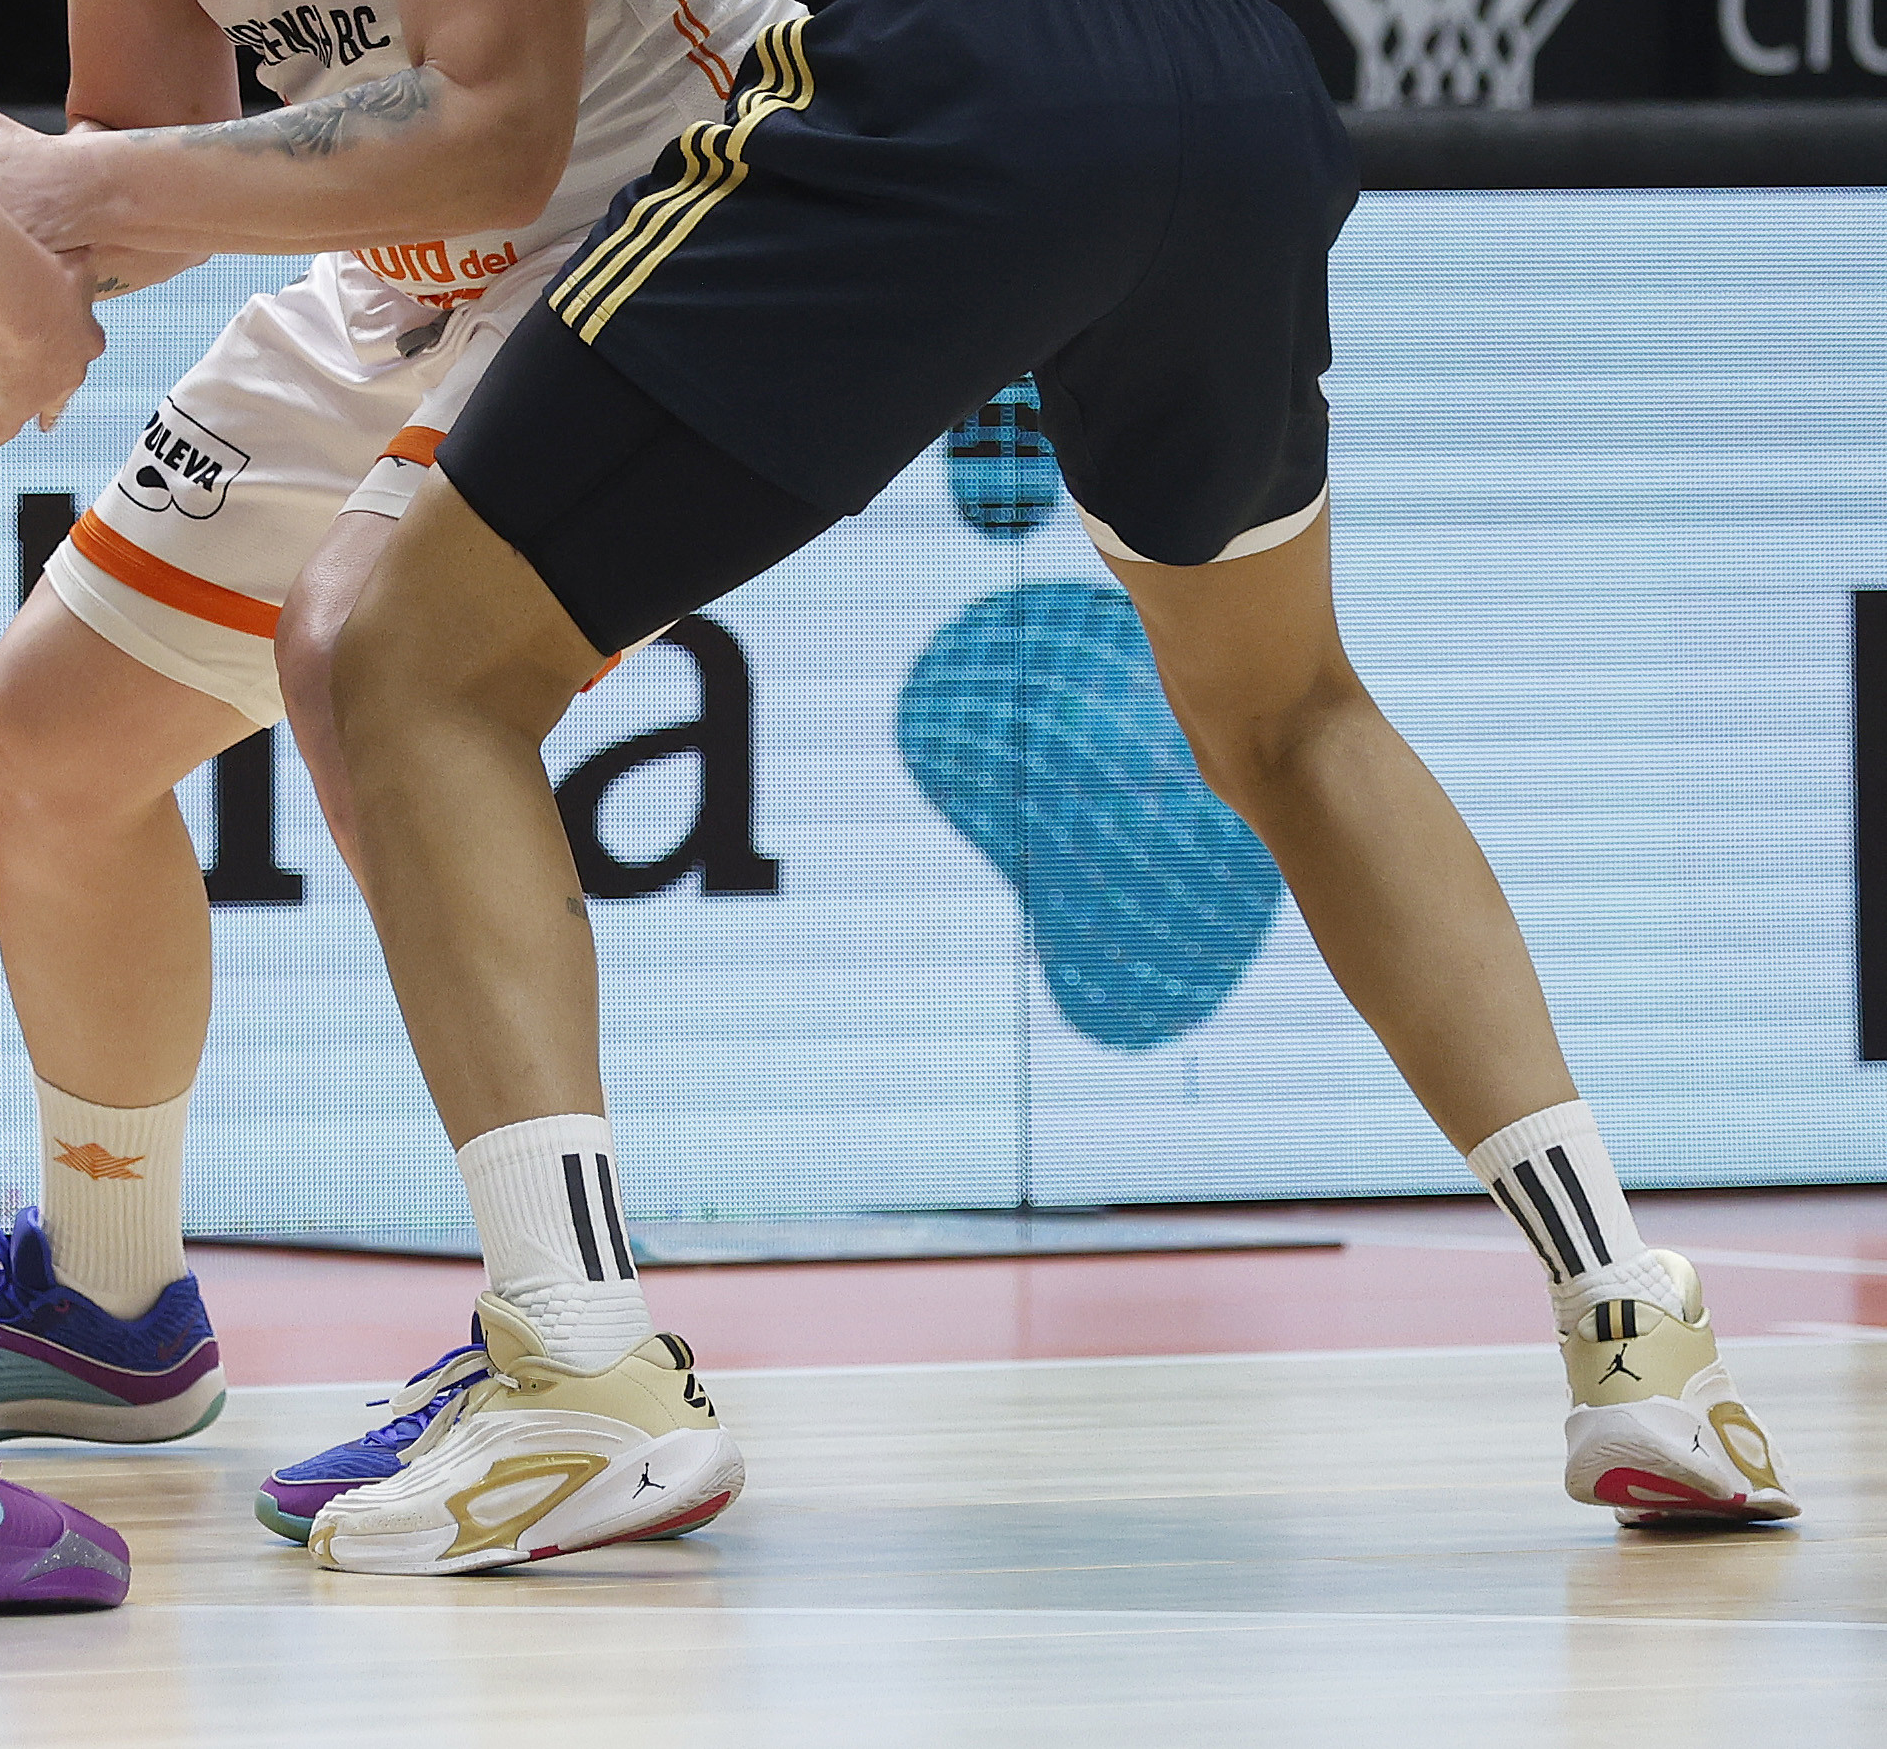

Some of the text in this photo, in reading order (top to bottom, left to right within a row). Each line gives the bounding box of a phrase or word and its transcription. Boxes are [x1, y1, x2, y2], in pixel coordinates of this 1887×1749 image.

[329, 5, 391, 66] BC
[459, 241, 518, 280] del
[144, 410, 223, 493] ULEVA
